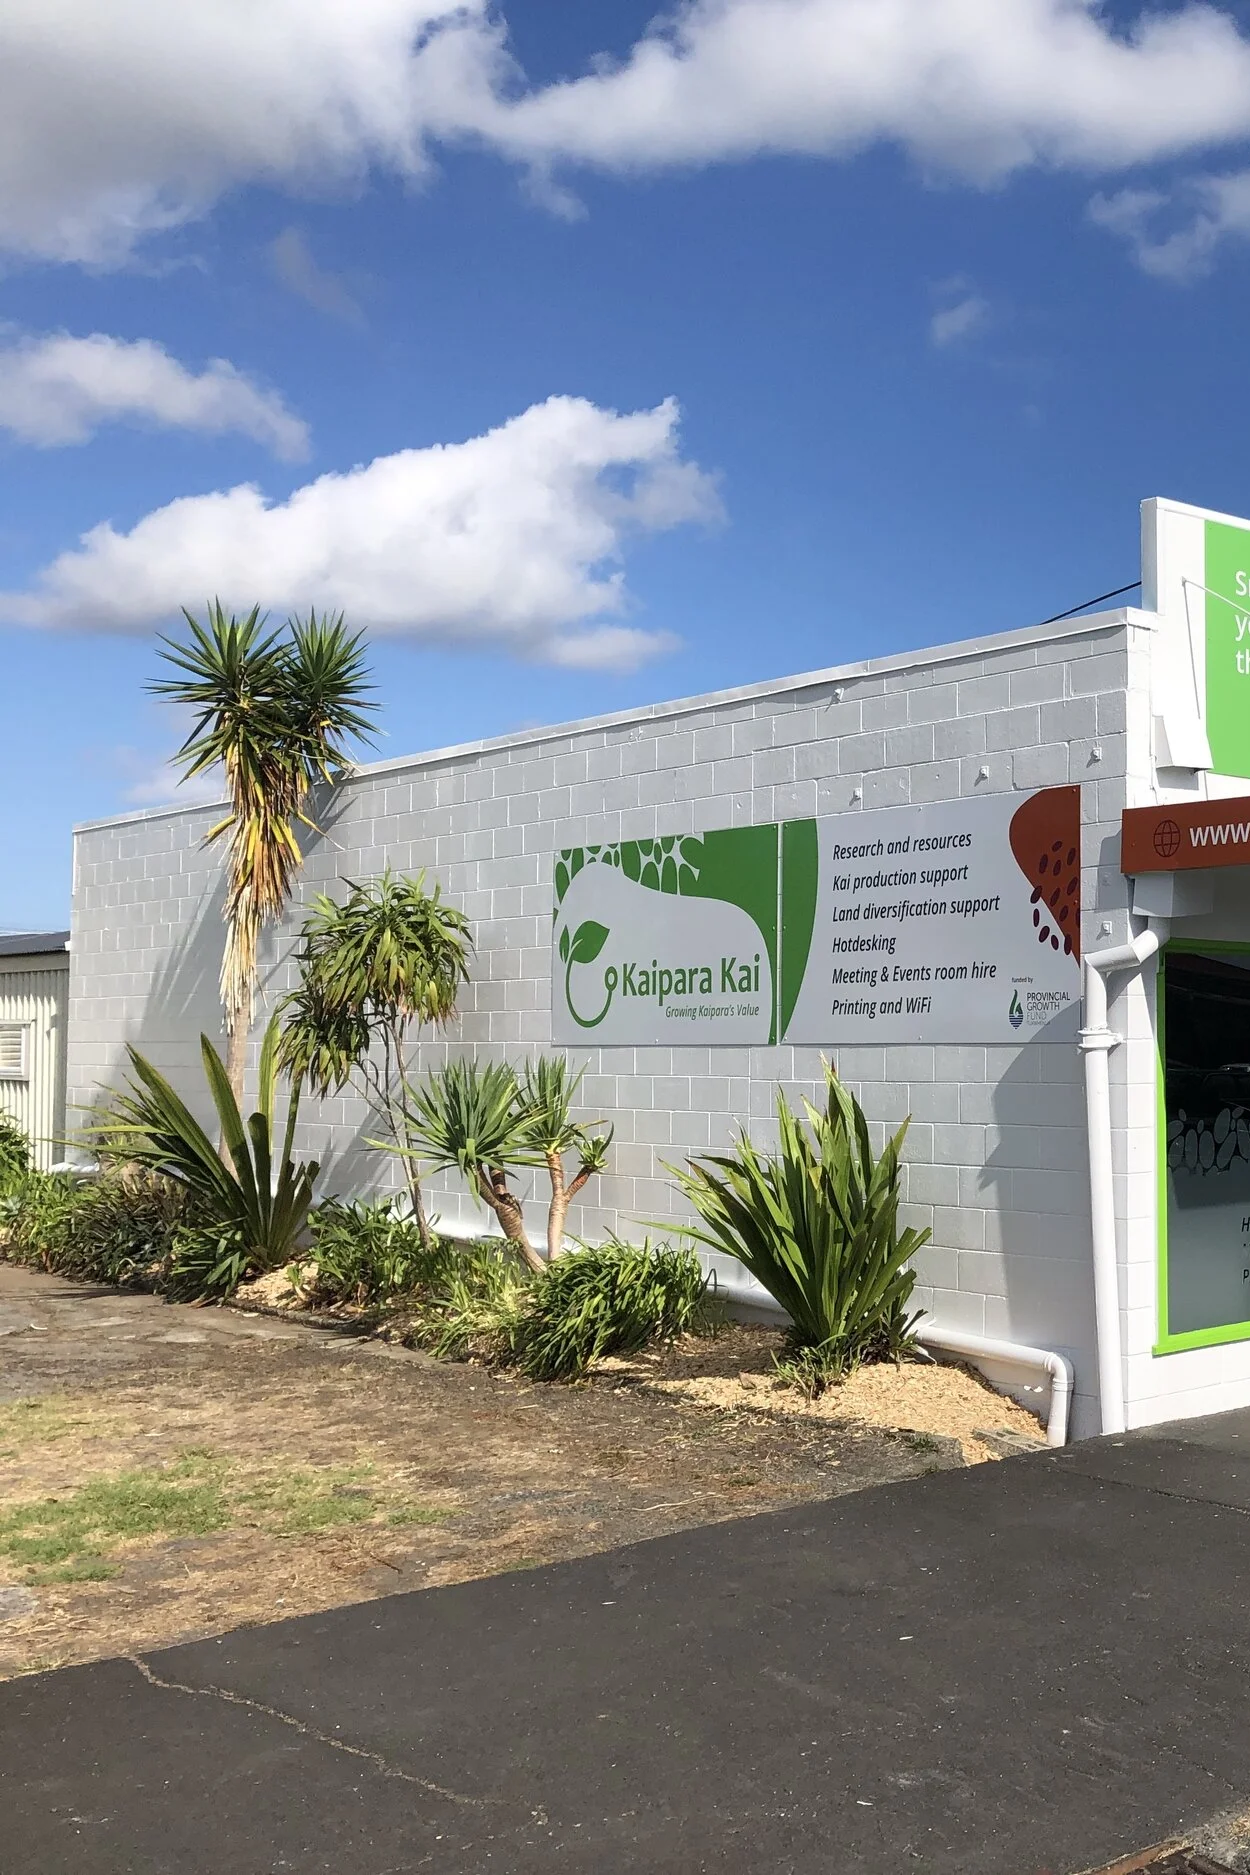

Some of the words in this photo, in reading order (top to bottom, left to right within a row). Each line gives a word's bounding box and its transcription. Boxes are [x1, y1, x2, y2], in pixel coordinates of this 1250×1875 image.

[833, 839, 883, 860] Research
[887, 836, 910, 854] and
[913, 833, 972, 852] resources
[833, 874, 850, 891] Kai
[853, 869, 917, 894] production
[920, 865, 968, 887] support
[833, 904, 861, 922] Land
[863, 899, 946, 922] diversification
[950, 895, 1000, 918] support
[832, 934, 896, 955] Hotdesking
[623, 959, 712, 1006] Kaipara
[721, 953, 760, 993] Kai
[832, 967, 878, 987] Meeting
[881, 966, 889, 982] &
[892, 965, 931, 982] Events
[934, 964, 968, 980] room
[971, 961, 997, 979] hire
[832, 999, 877, 1019] Printing
[879, 997, 902, 1014] and
[906, 996, 931, 1013] WiFi
[1027, 992, 1070, 1001] PROVINCIAL
[1027, 1002, 1059, 1011] GROWTH
[665, 1005, 697, 1020] Growing
[699, 1004, 734, 1020] Kaipara's
[737, 1003, 759, 1016] Value
[1027, 1011, 1047, 1020] FUND
